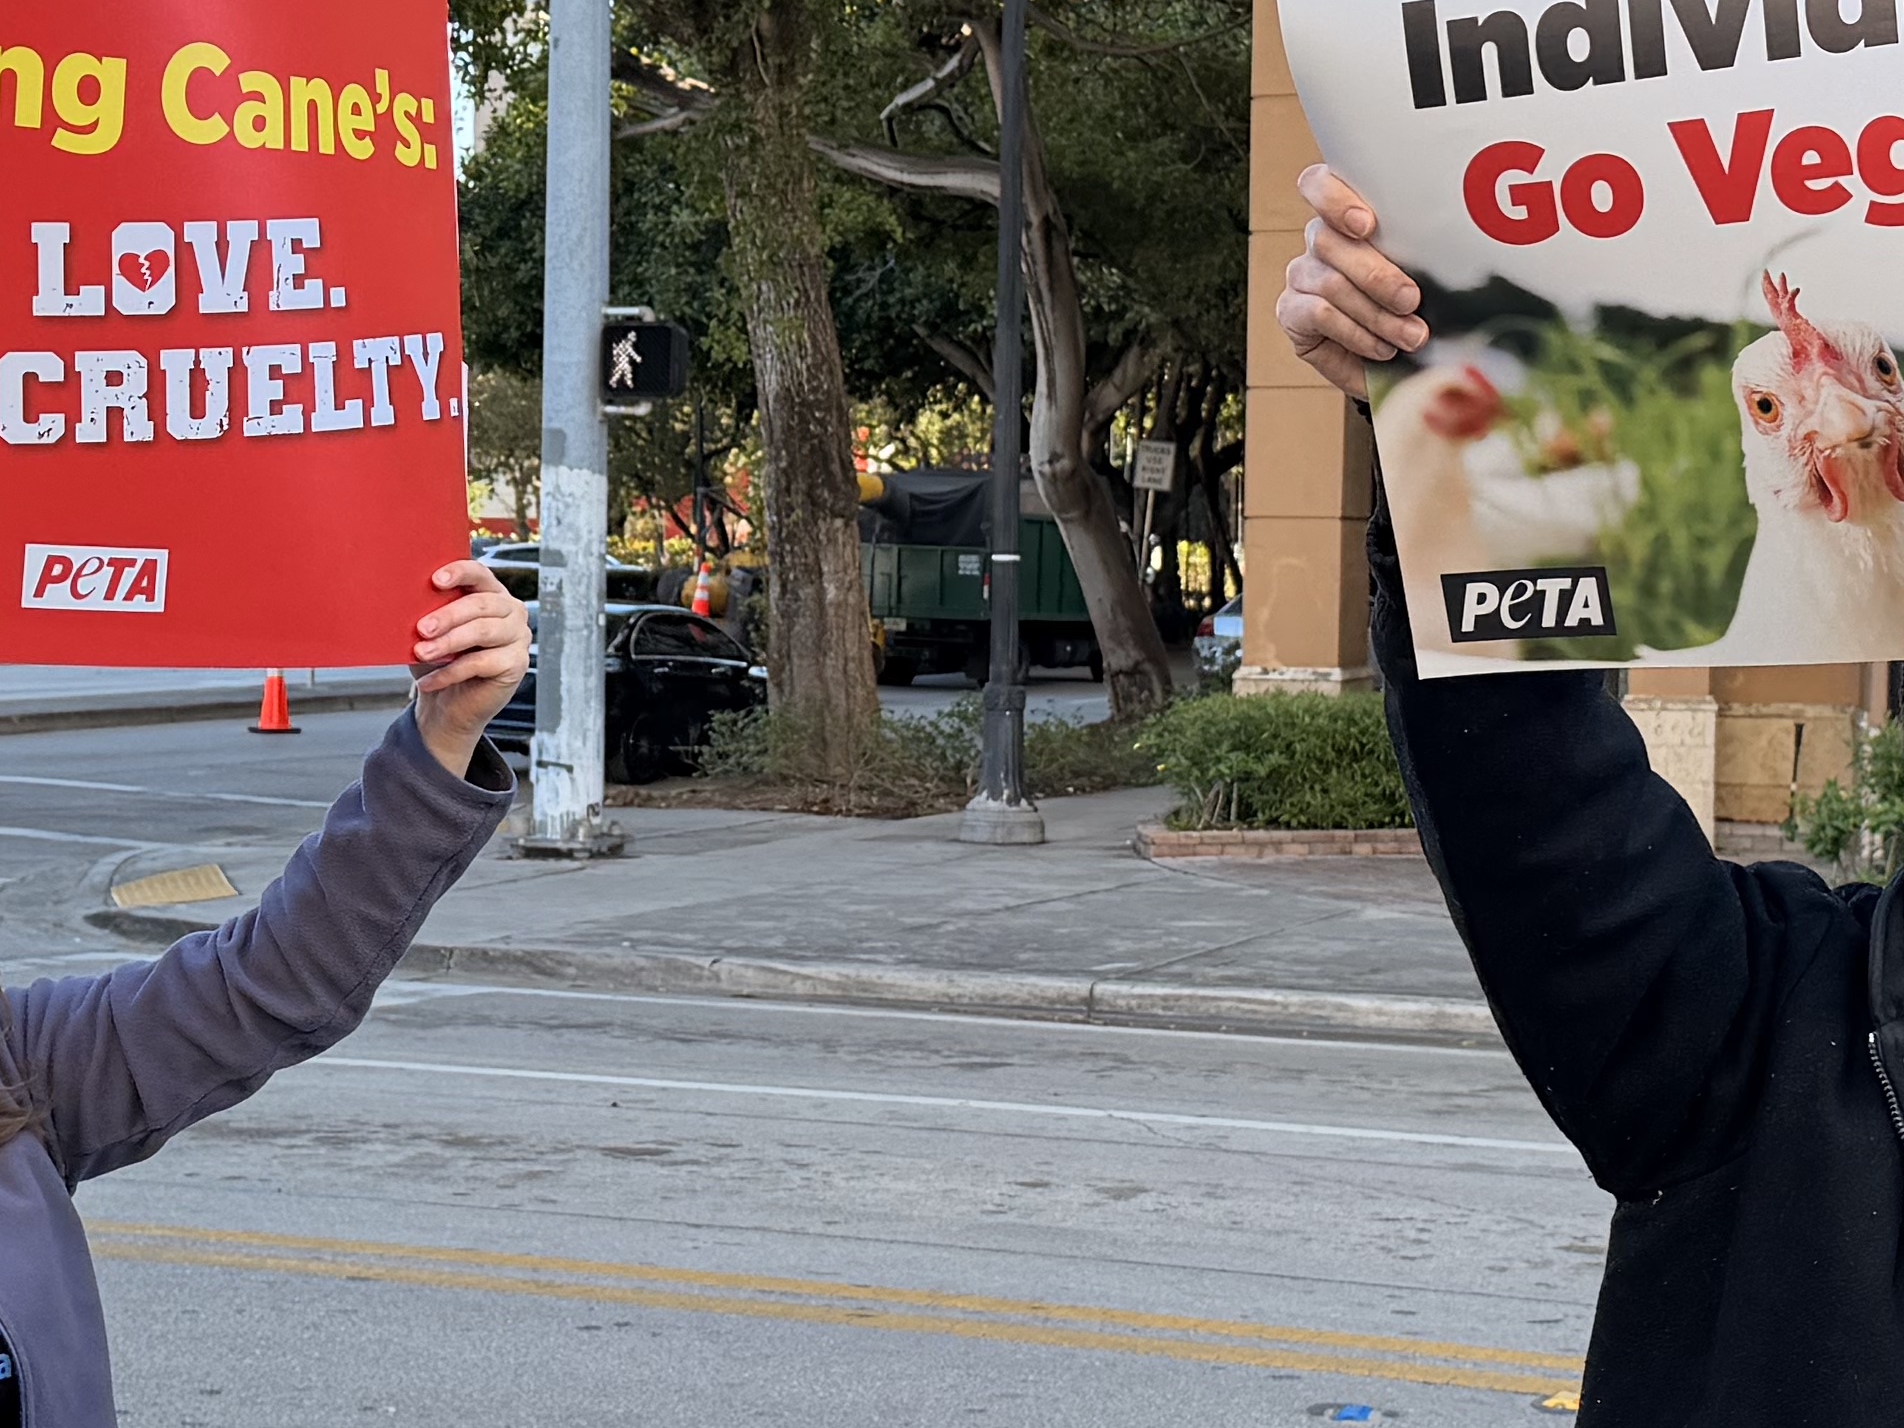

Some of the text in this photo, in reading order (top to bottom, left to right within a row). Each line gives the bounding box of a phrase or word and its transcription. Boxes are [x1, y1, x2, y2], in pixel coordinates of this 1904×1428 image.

[162, 42, 437, 169] Cane's:
[1465, 142, 1644, 245] Go
[32, 218, 346, 316] LOVE.
